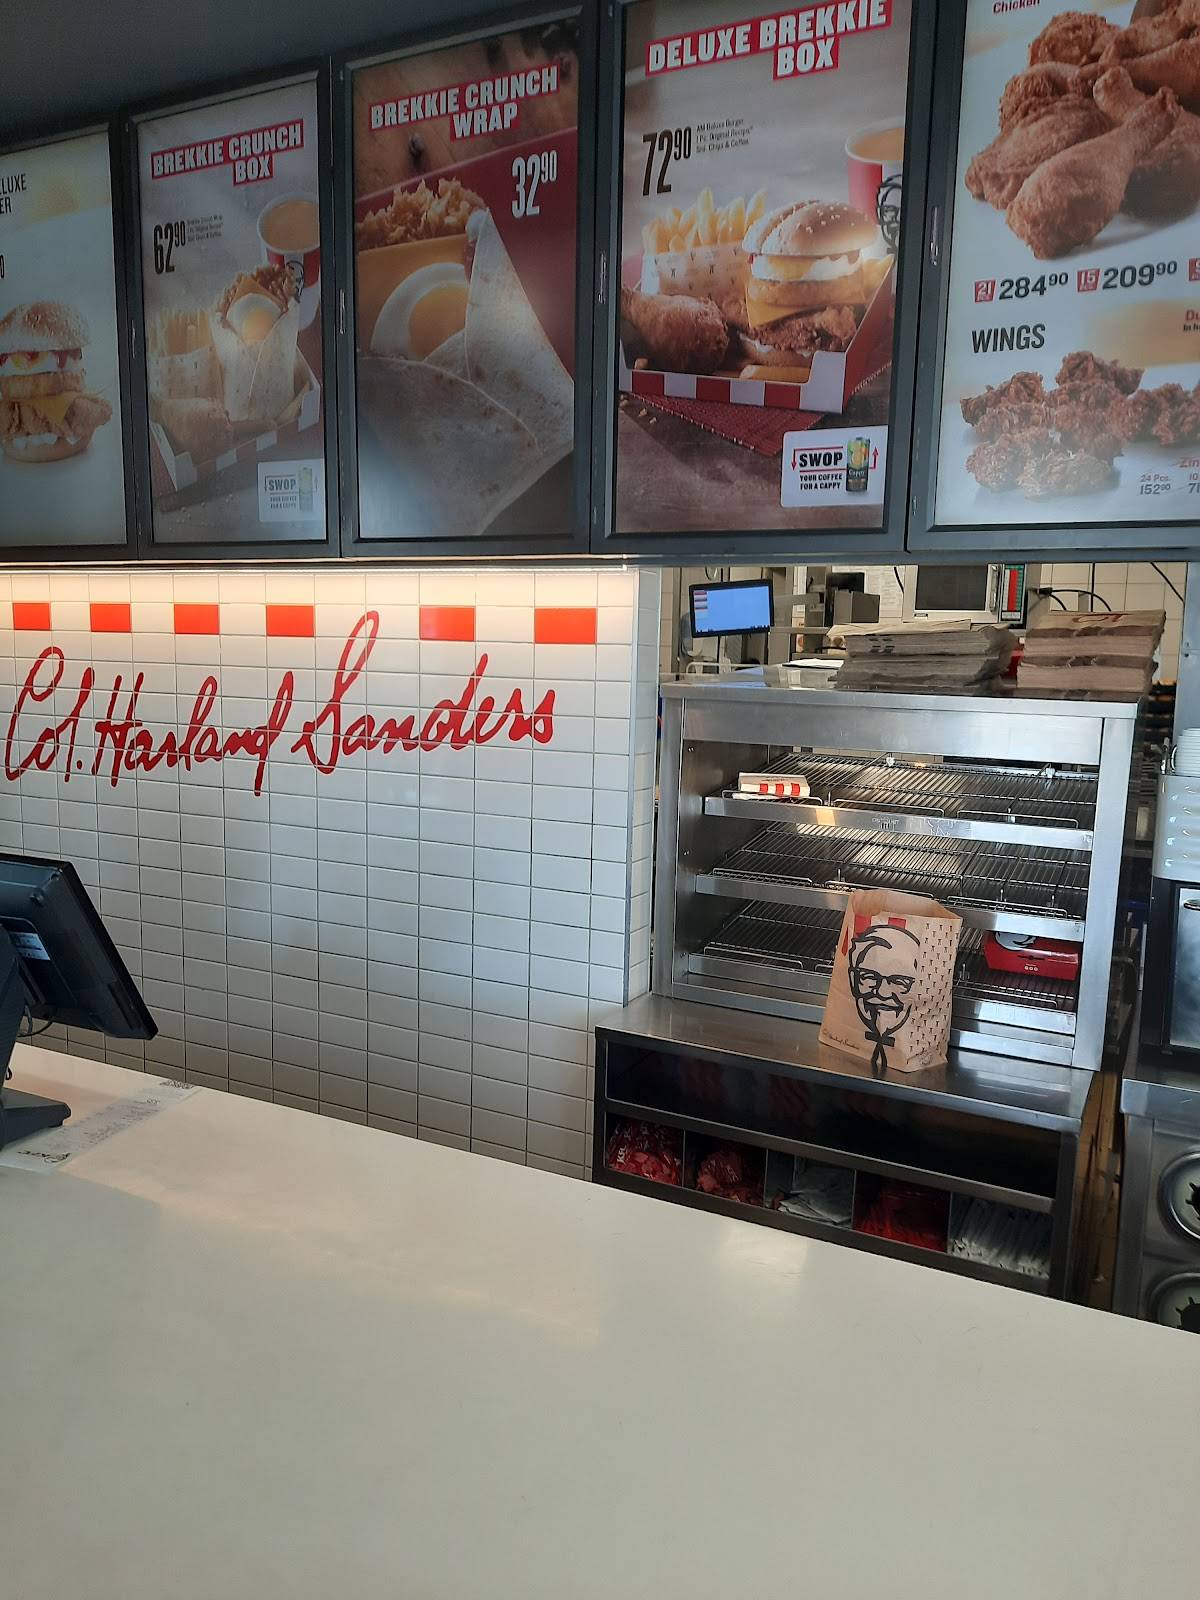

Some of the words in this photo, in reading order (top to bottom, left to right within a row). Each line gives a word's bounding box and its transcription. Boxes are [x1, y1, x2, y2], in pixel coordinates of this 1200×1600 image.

[648, 25, 752, 73] DELUXE
[759, 0, 888, 49] BREKKIE
[776, 37, 835, 78] BOX
[370, 87, 460, 130] BREKKIE
[464, 65, 559, 110] CRUNCH
[452, 102, 519, 139] WRAP
[153, 142, 224, 177] BREKKIE
[227, 122, 302, 160] CRUNCH
[0, 174, 27, 195] LUXE
[234, 154, 271, 184] BOX
[971, 323, 1047, 354] WINGS
[799, 451, 843, 468] SWOP
[267, 478, 296, 491] SWOP
[799, 474, 817, 482] YOUR
[818, 472, 843, 481] COFFEE
[800, 482, 813, 490] FOR
[819, 482, 841, 490] CAPPY
[290, 610, 556, 775] Sanders
